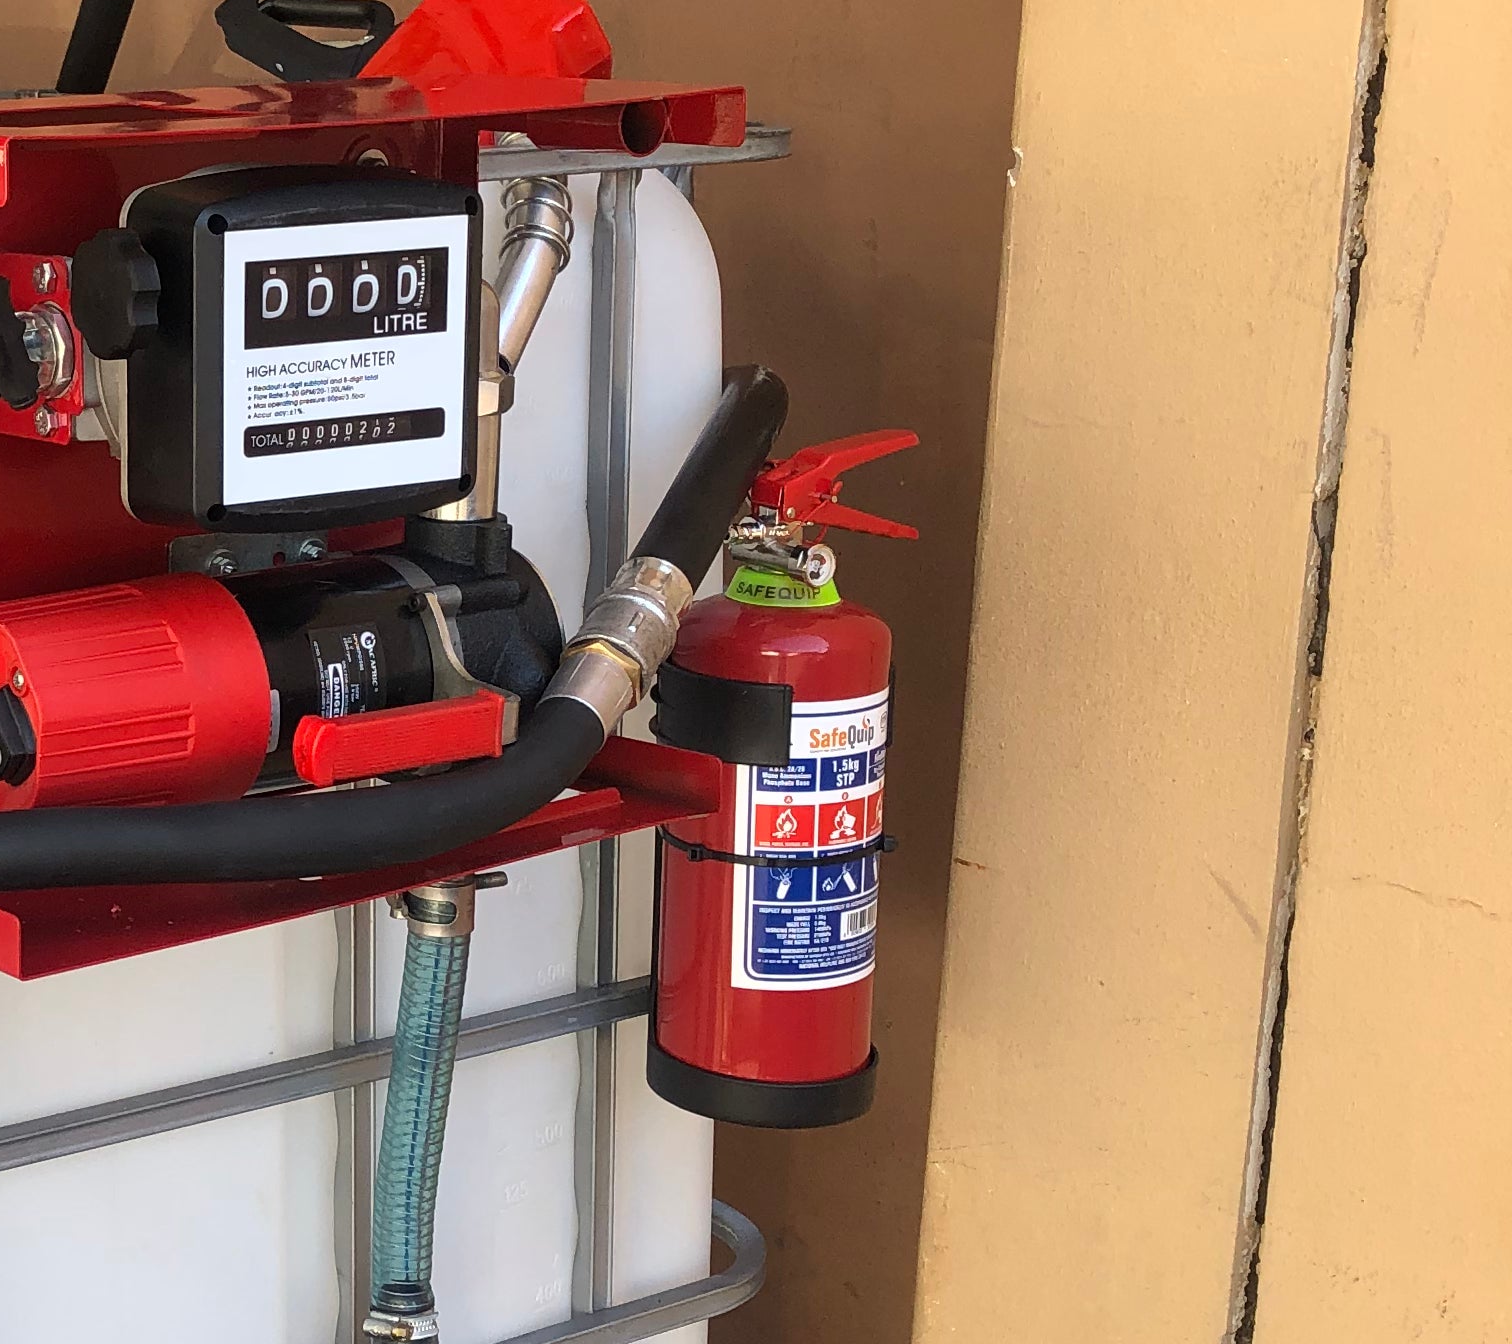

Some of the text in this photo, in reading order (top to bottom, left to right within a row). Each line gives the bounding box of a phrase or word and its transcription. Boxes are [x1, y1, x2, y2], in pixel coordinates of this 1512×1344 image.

[373, 312, 428, 335] LITRE
[246, 350, 396, 379] HIGH ACCURACY METER
[251, 434, 284, 448] TOTAL
[736, 581, 821, 601] SAFEQUIP
[809, 720, 875, 750] SafeQuip
[832, 757, 860, 773] 1.5kg
[835, 771, 855, 787] STP
